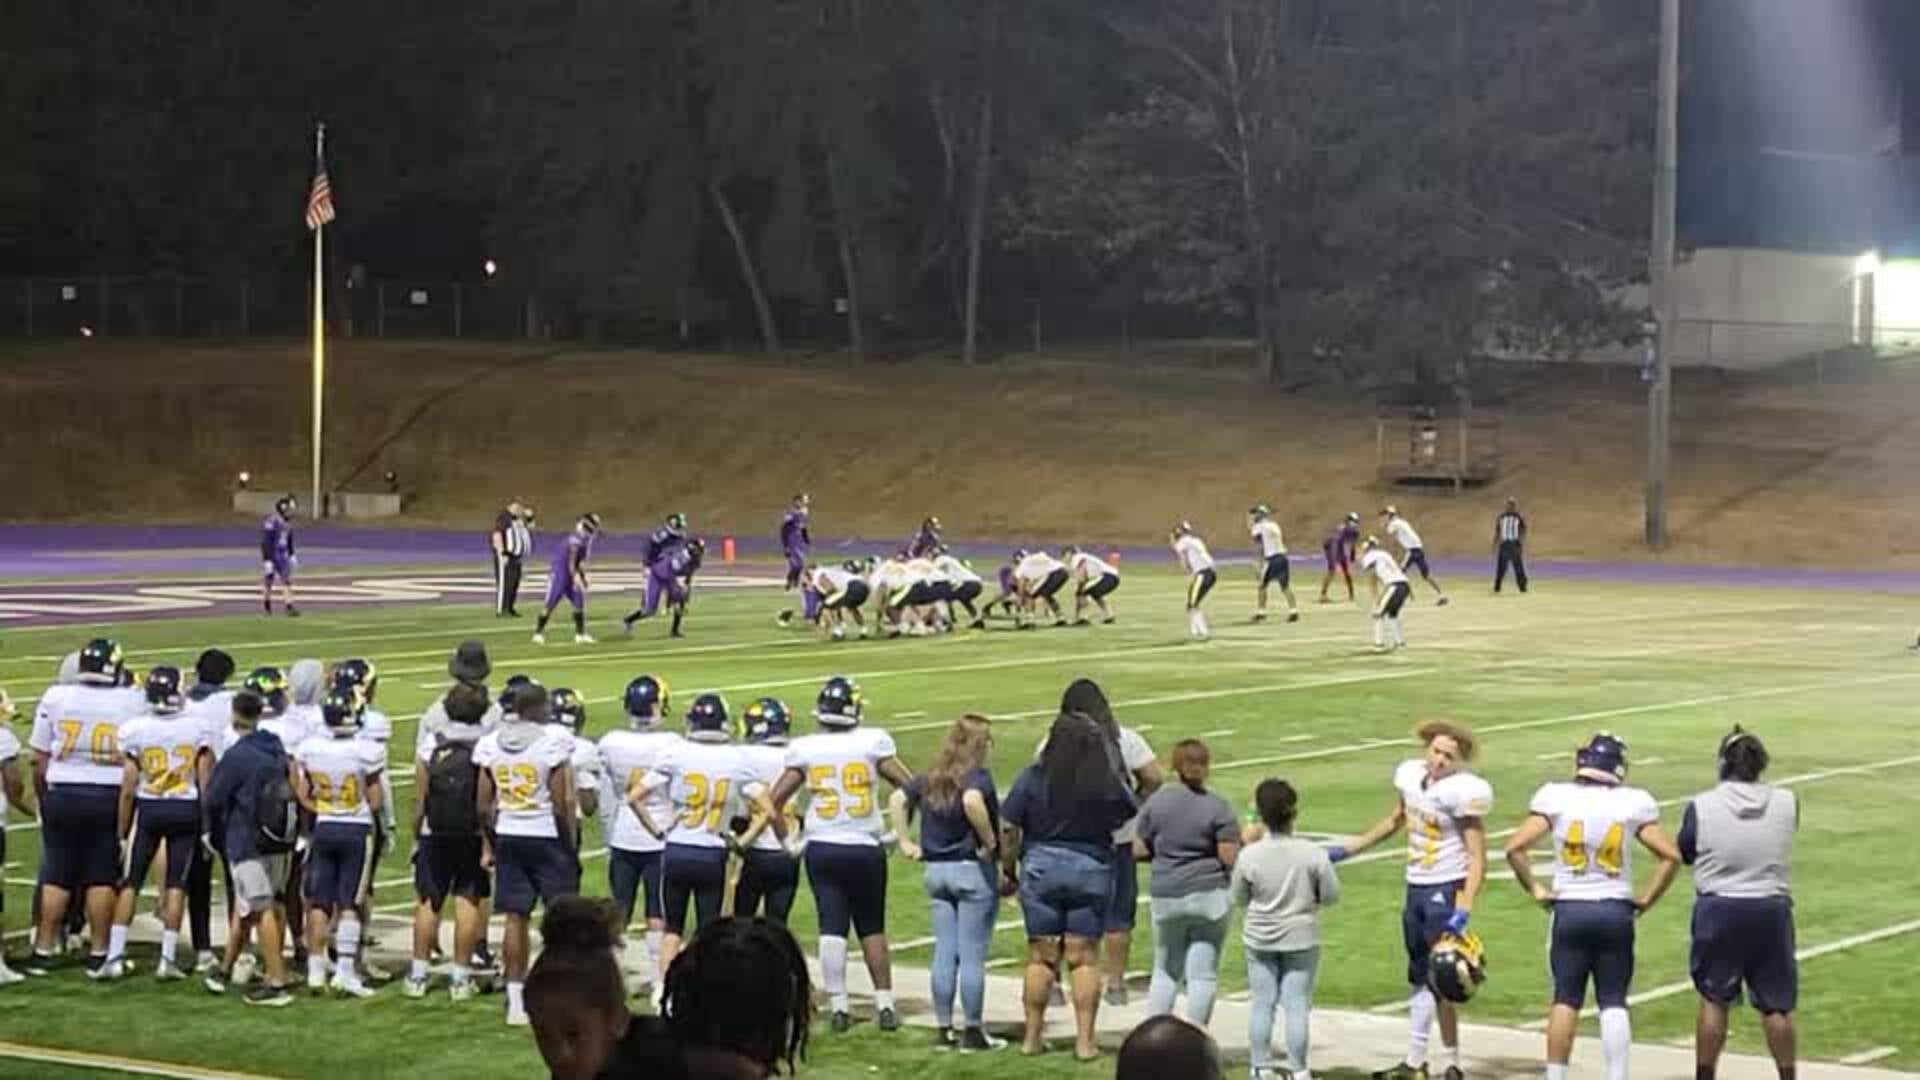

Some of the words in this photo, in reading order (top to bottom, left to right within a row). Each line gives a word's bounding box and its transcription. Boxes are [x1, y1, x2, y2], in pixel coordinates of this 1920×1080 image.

[58, 719, 118, 765] 70
[682, 772, 731, 832] 31
[809, 762, 873, 819] 59
[1562, 819, 1624, 877] 44
